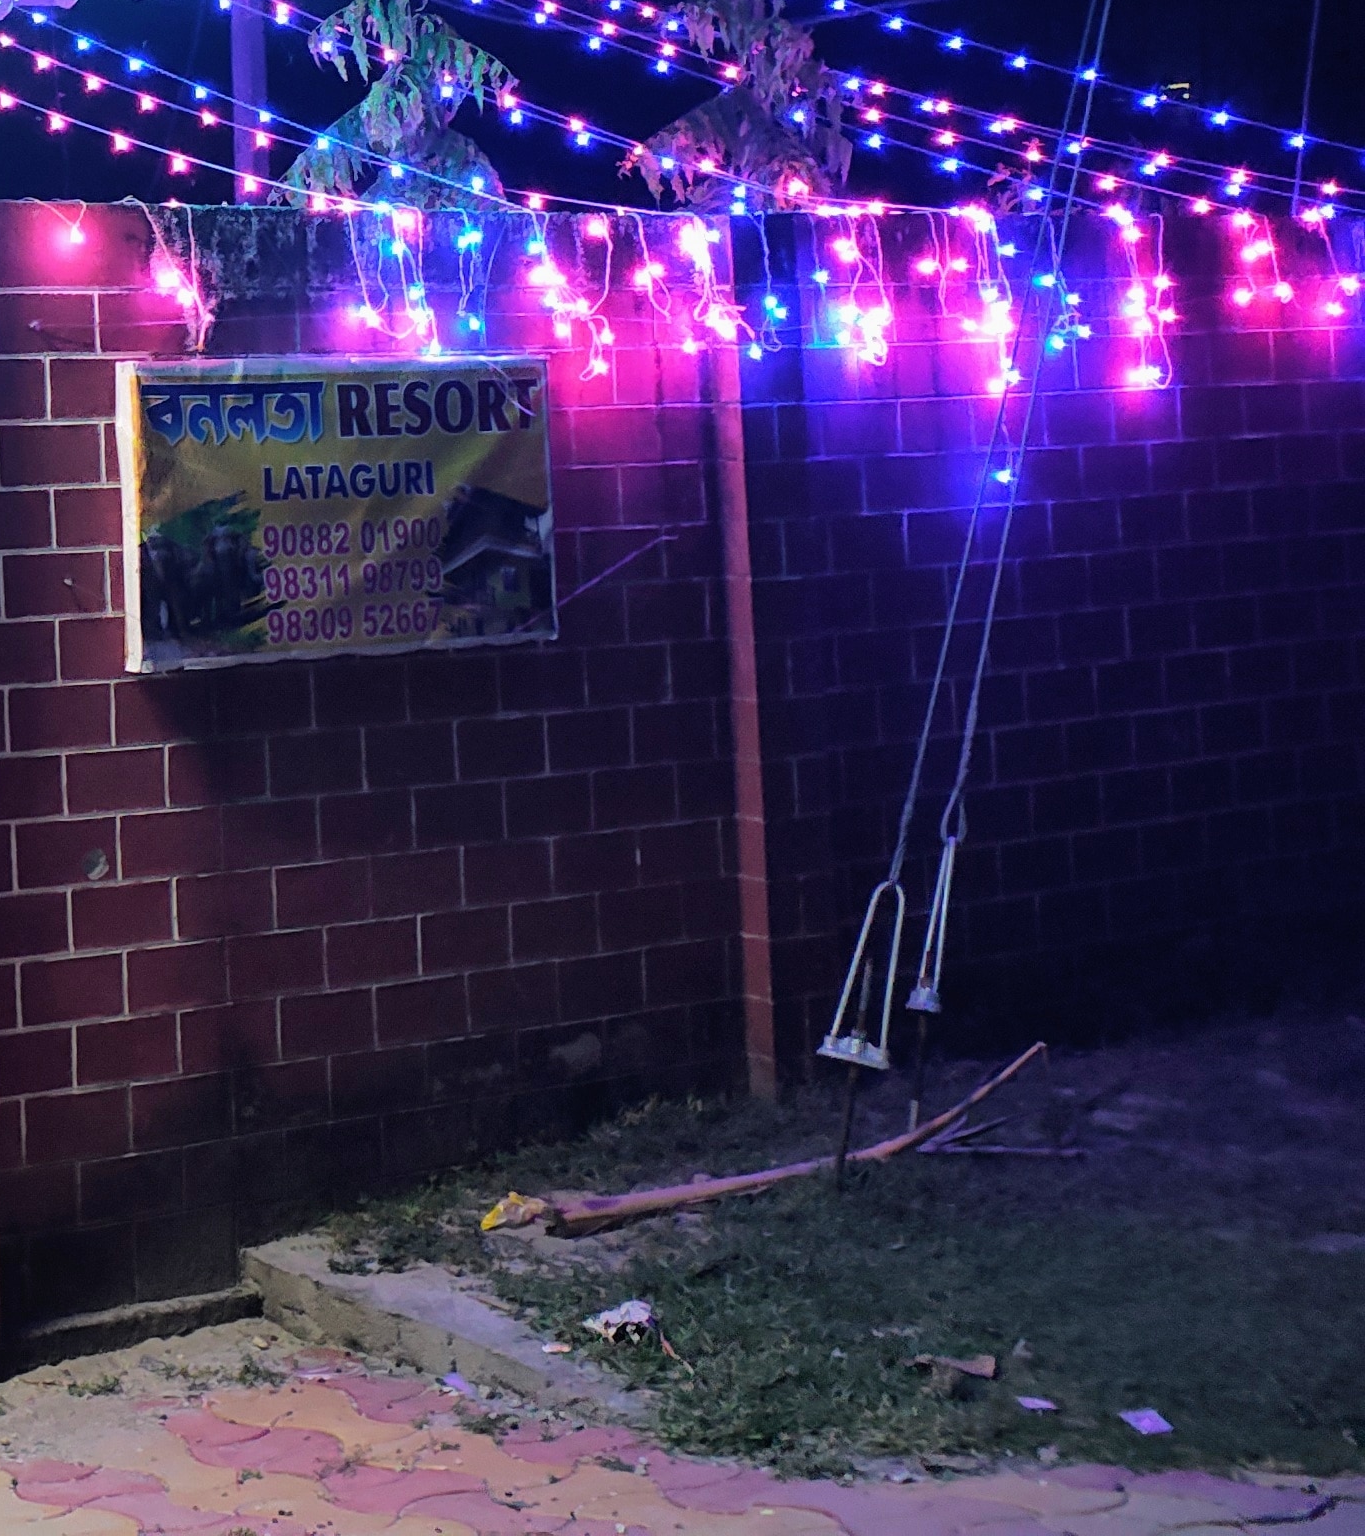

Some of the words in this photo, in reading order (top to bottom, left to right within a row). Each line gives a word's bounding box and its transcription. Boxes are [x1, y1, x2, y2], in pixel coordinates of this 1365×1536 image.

[141, 381, 324, 445] বনলতা
[337, 378, 538, 438] RESORT
[263, 460, 435, 502] LATAGURI
[263, 522, 350, 558] 90882
[361, 517, 441, 554] 01900
[265, 565, 350, 601] 98311
[362, 559, 444, 594] 98799
[269, 609, 352, 644] 98309
[363, 602, 444, 637] 52667
